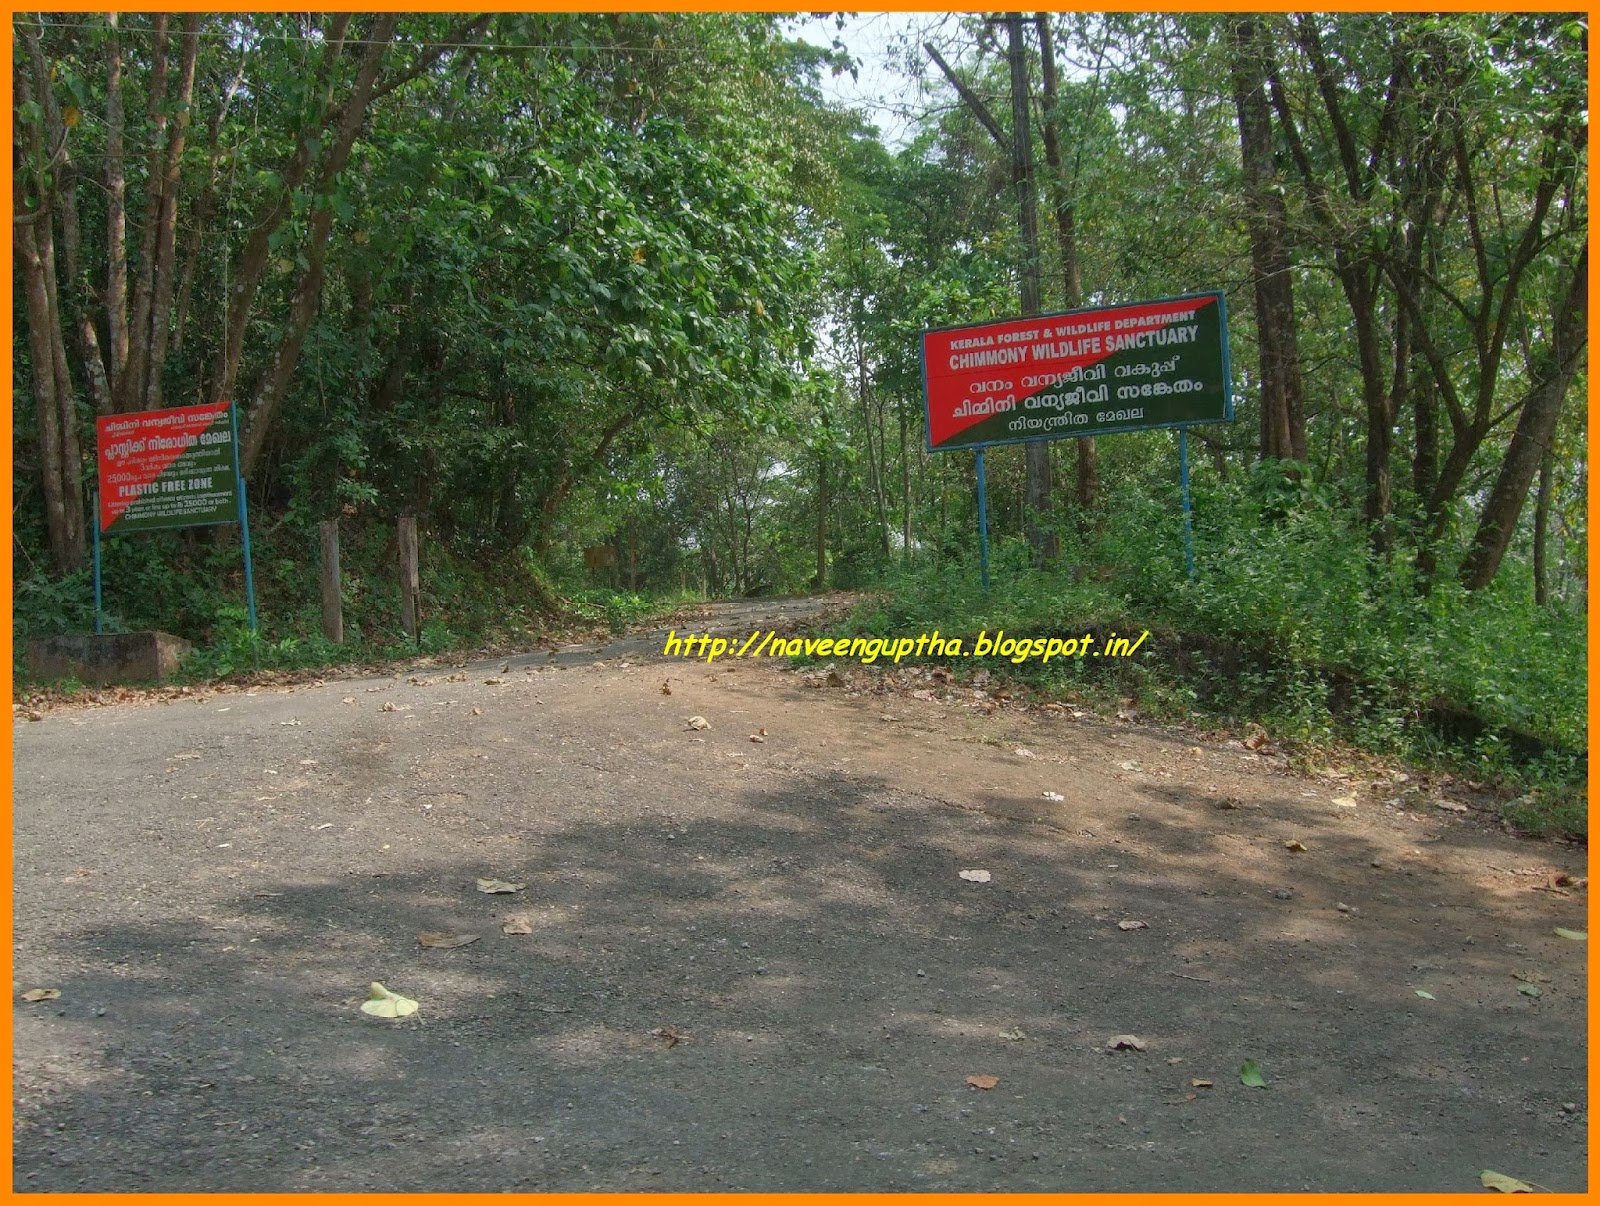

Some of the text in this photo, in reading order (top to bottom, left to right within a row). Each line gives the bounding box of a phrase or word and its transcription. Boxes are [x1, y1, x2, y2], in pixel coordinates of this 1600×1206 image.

[949, 325, 1199, 370] CHIMMONY WILDLIFE SANCTUARY
[950, 310, 1195, 350] KERALA FOREST & WILDLIFE DEPARTMENT
[969, 355, 1181, 395] വനം വന്യജീവി വകുപ്പ്
[952, 379, 1203, 418] ചിമ്മിനി വന്യജീവി സങ്കേതം
[1096, 407, 1144, 423] മേഖല
[119, 477, 213, 497] PLASTIC FREE ZONE
[125, 506, 131, 514] 3
